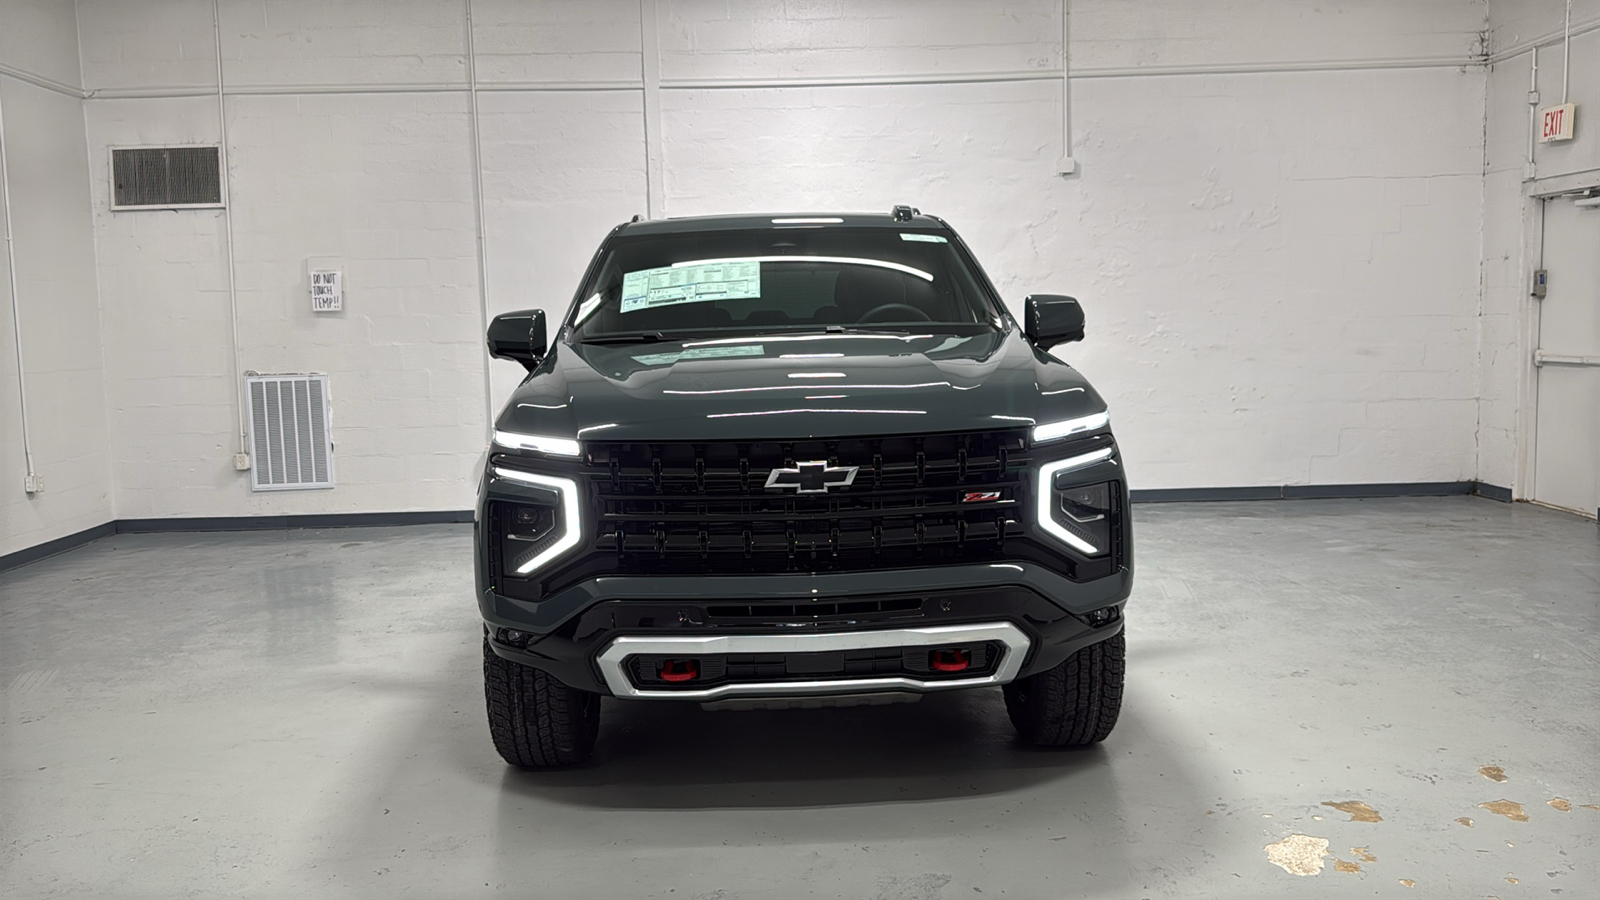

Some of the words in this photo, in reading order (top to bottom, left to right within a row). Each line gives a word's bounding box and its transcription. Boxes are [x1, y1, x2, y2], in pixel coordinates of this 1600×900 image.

[1544, 110, 1563, 137] EXIT
[313, 274, 321, 284] DO
[323, 273, 337, 284] NOT
[313, 286, 332, 296] TOUCH
[314, 296, 339, 309] TEMP!!
[962, 492, 1001, 502] Z71
